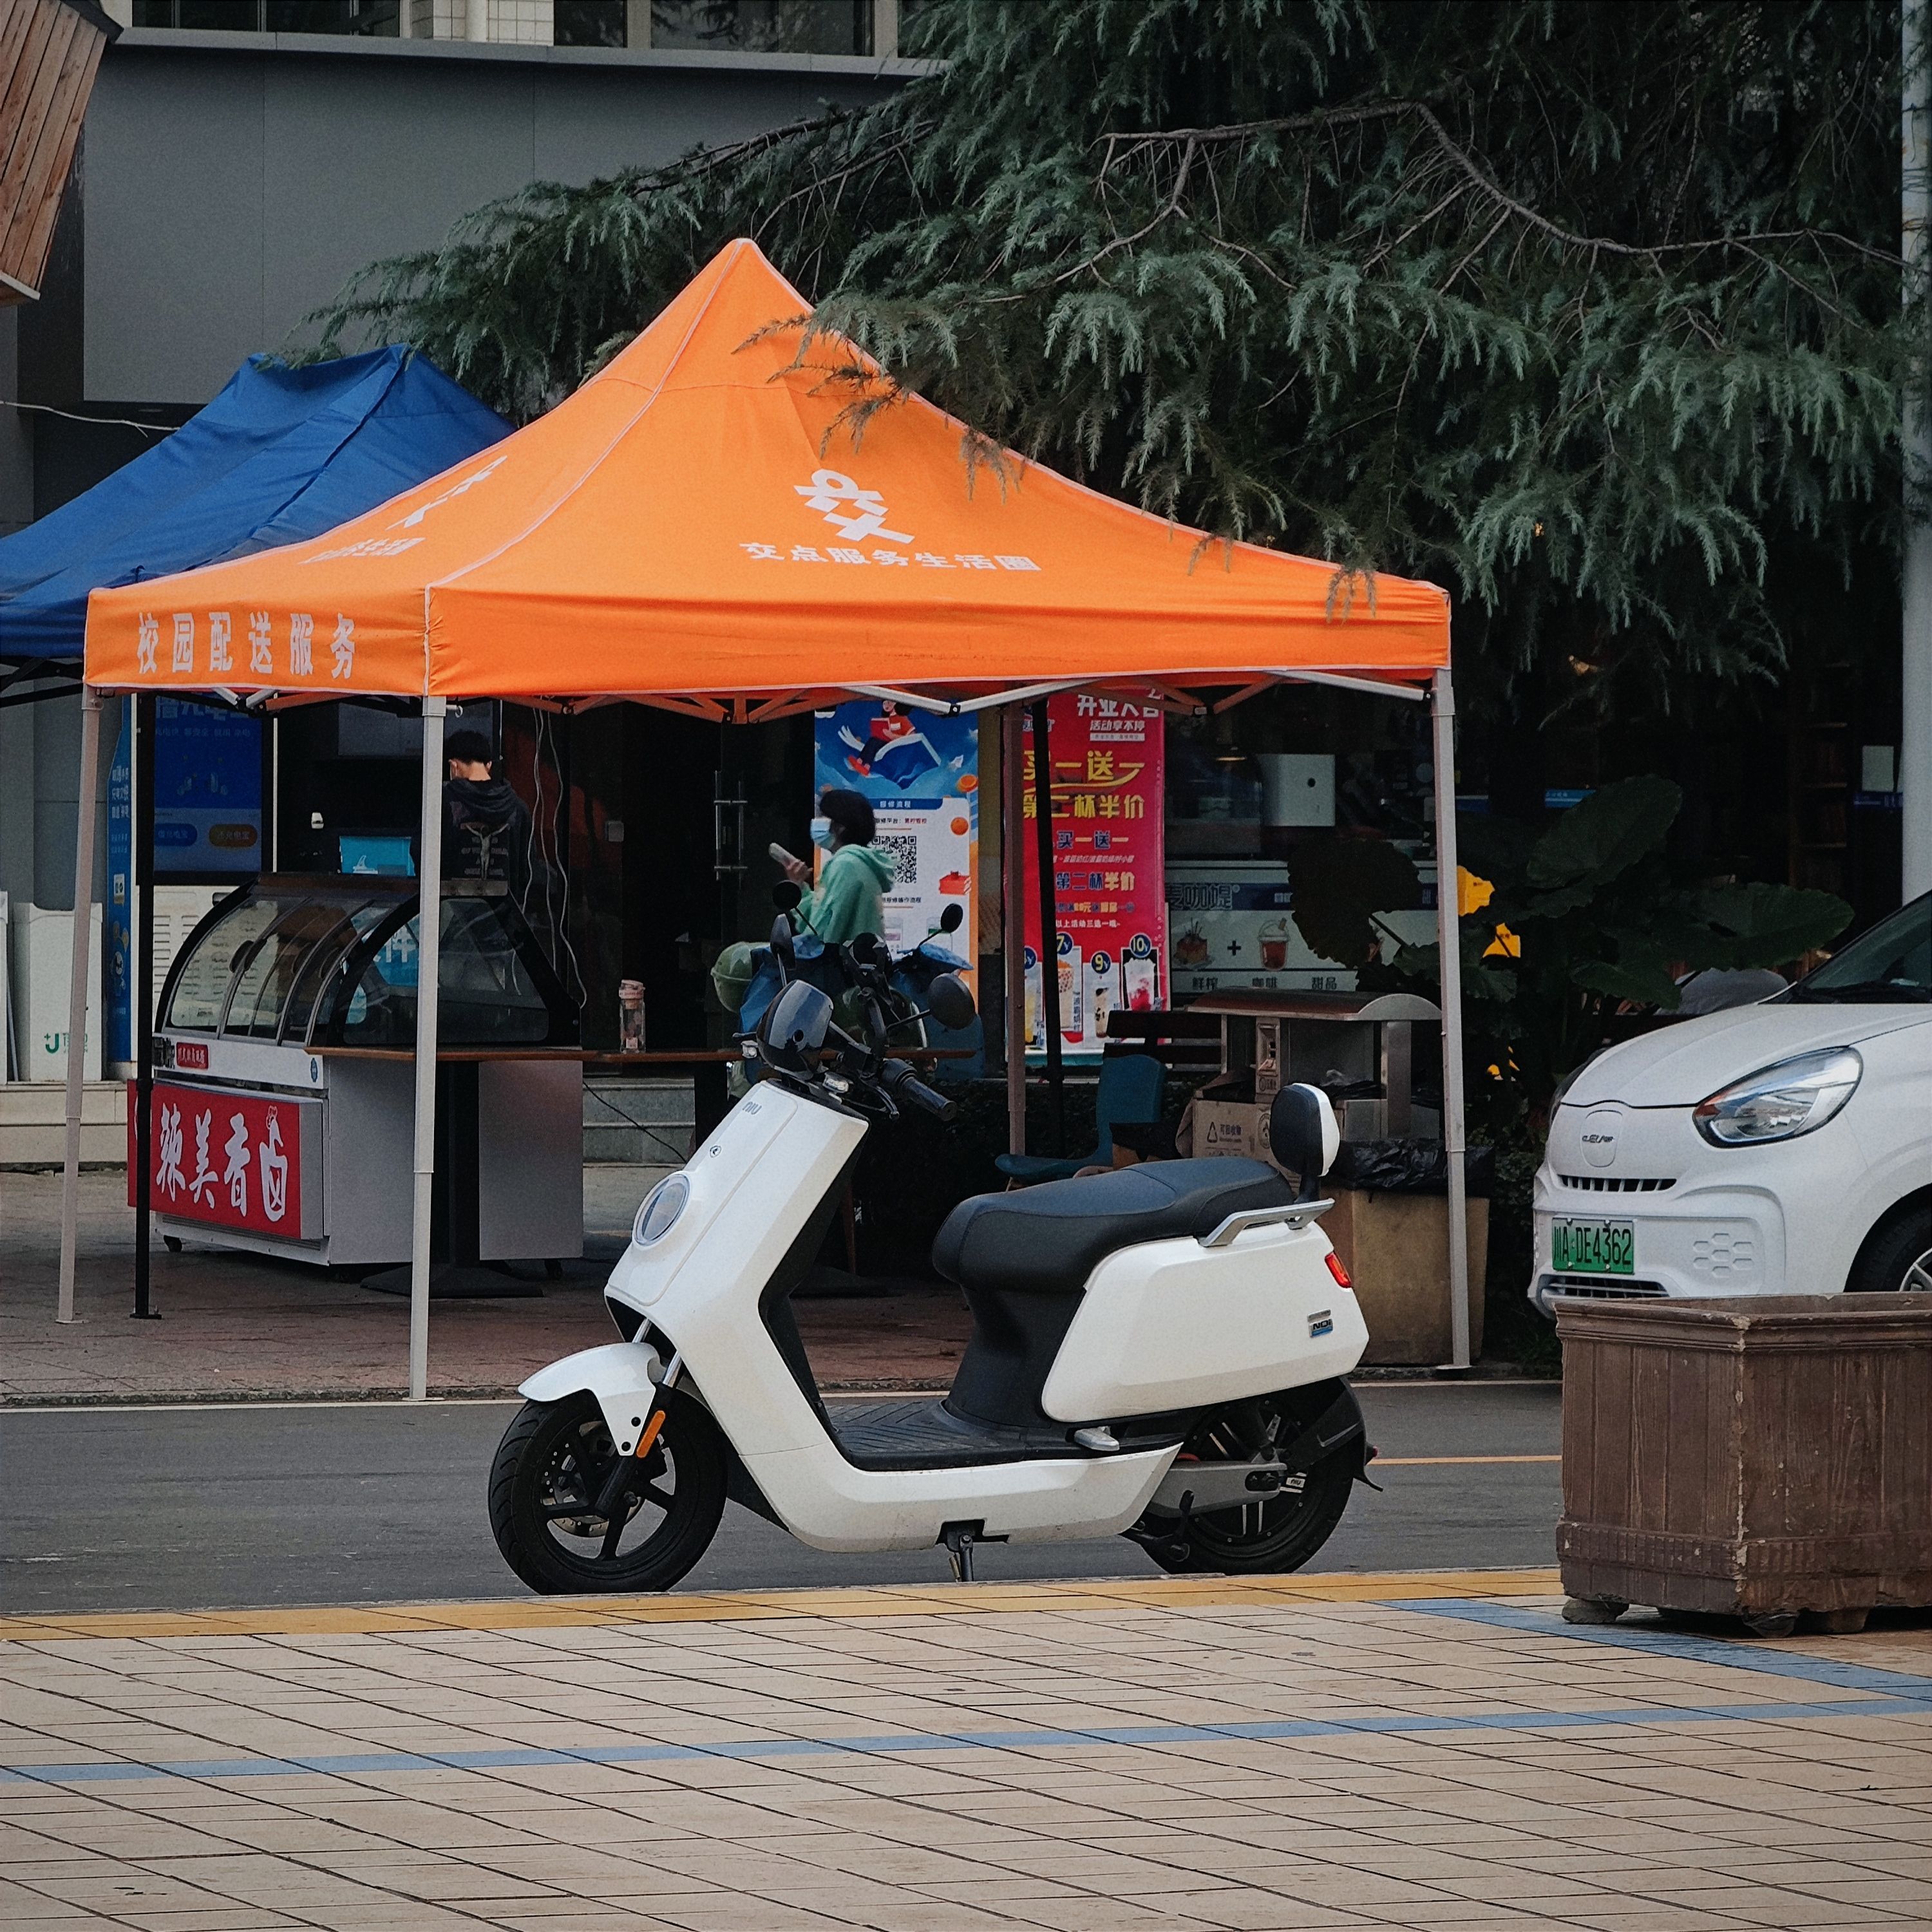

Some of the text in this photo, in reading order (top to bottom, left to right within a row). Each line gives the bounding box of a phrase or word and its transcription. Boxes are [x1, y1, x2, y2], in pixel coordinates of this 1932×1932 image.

[739, 542, 1042, 571] 交点服务生活圈
[137, 612, 355, 679] 校园配送服务
[1023, 793, 1144, 819] 第二杯半价
[1057, 830, 1130, 849] 买一送一
[1056, 871, 1135, 891] 第二杯半价
[1192, 976, 1218, 990] 鲜榨
[1311, 976, 1338, 990] 甜品
